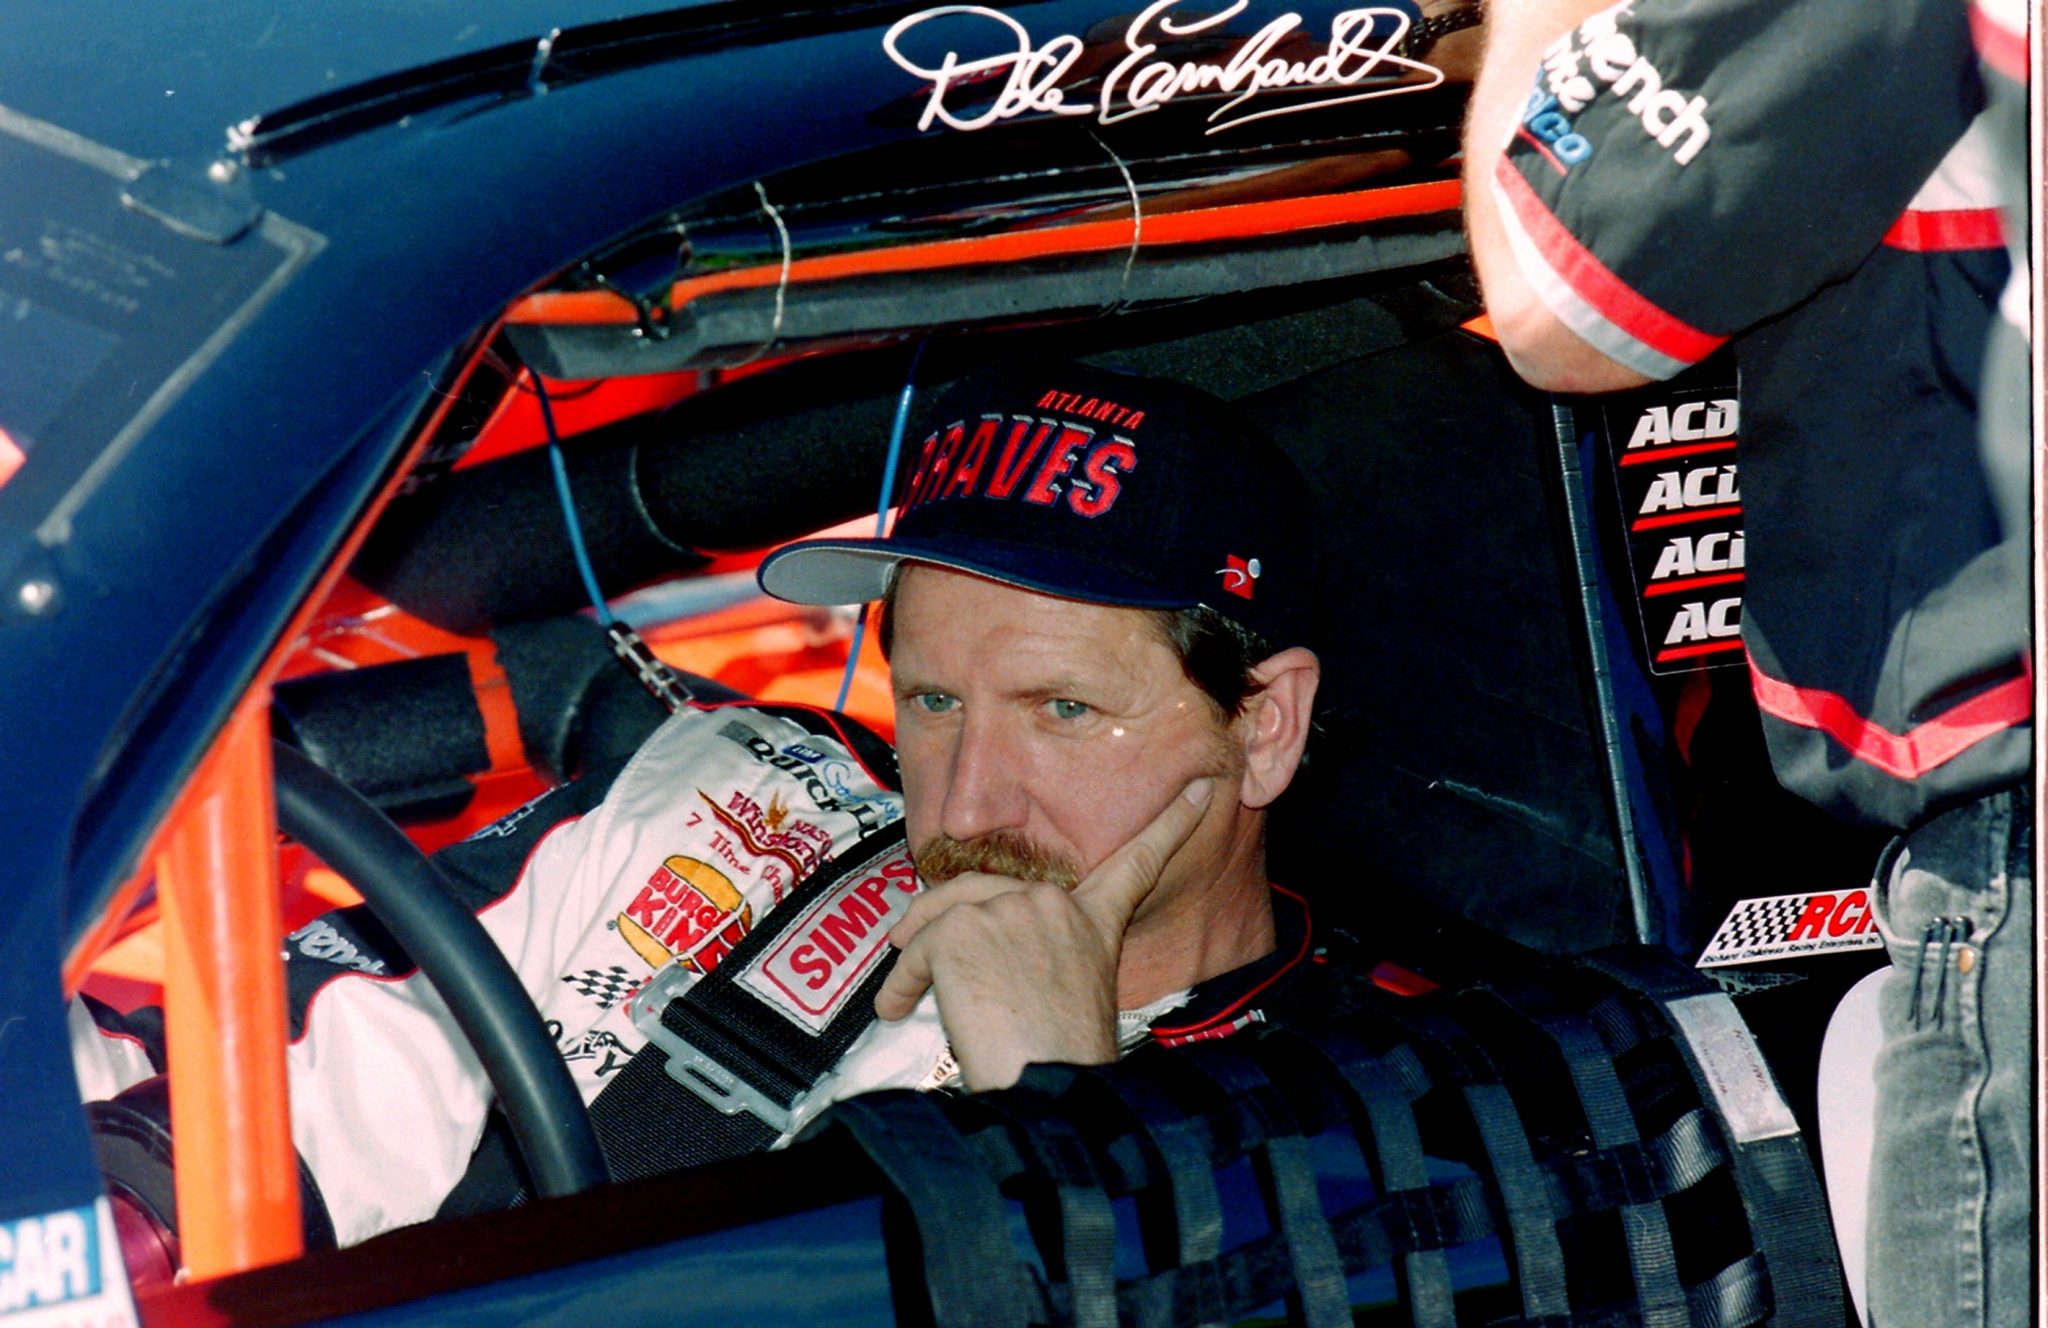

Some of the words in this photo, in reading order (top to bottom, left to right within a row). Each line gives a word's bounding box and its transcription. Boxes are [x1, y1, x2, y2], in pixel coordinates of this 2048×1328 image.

[1036, 390, 1146, 431] ATLANTA
[897, 413, 1140, 520] BRAVES
[686, 811, 703, 828] 7
[709, 830, 751, 876] Time
[1702, 951, 1739, 963] Richard
[1742, 946, 1785, 959] Childress
[1788, 942, 1817, 953] Racing
